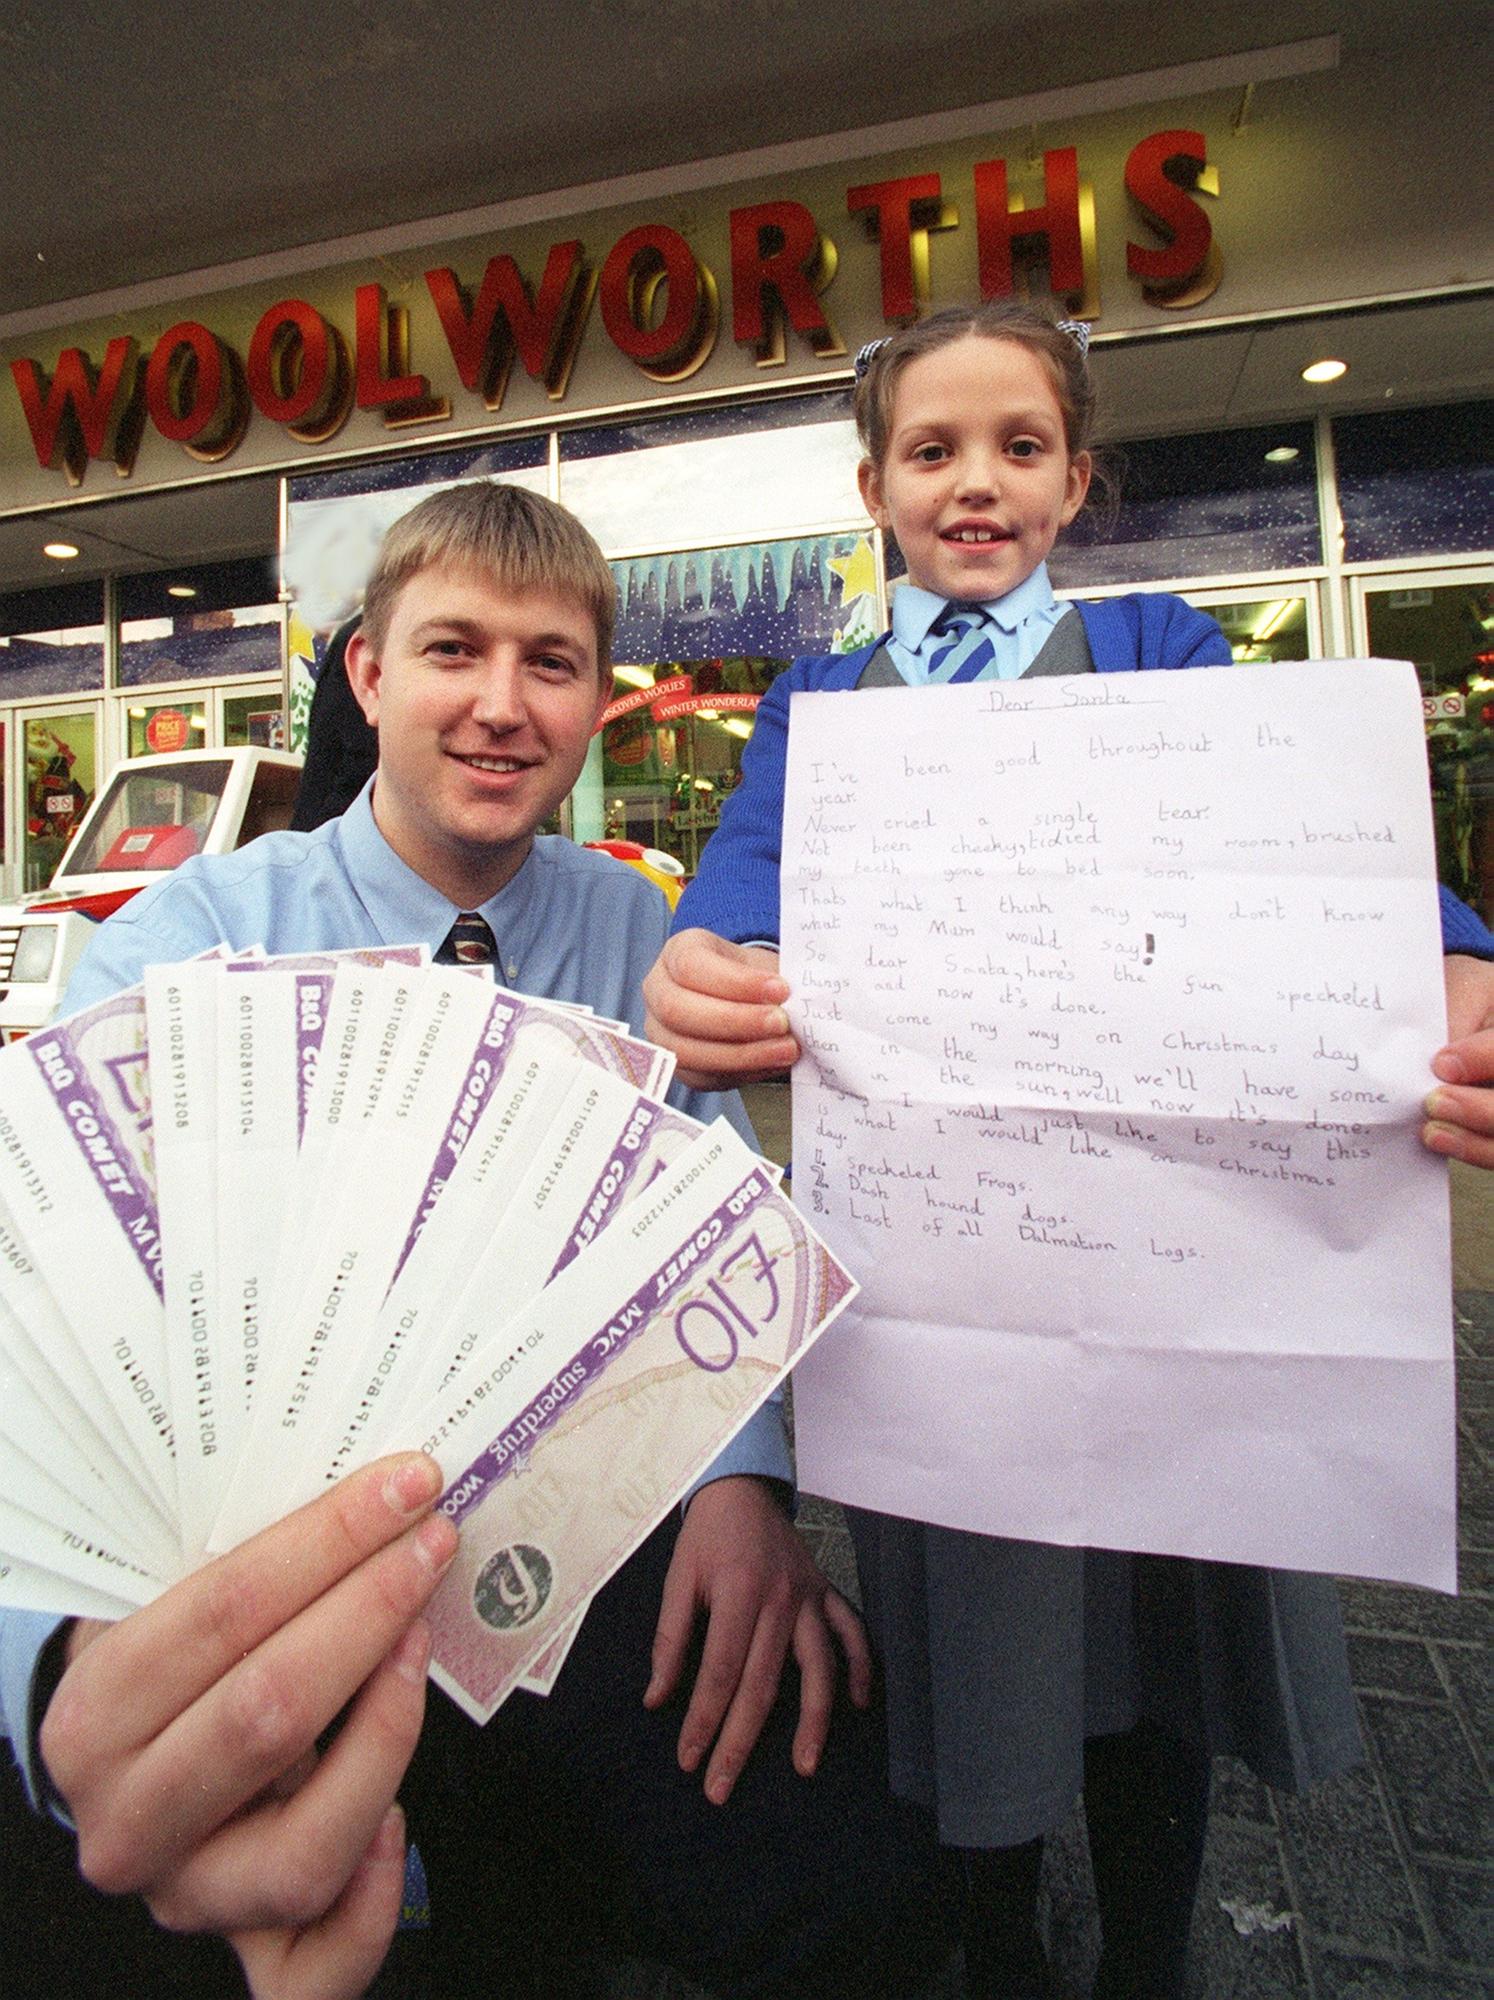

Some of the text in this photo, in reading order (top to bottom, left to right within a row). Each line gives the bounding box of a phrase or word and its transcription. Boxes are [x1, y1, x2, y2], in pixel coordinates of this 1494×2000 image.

[10, 129, 1218, 472] WOOLWORTHS
[644, 679, 687, 700] WOOLIES
[659, 700, 699, 717] WINTER
[989, 682, 1132, 713] Dear Santa
[810, 722, 1297, 784] I've been good throughout the
[800, 838, 832, 857] Not
[871, 834, 912, 855] been
[1151, 832, 1184, 857] my
[803, 814, 857, 835] Never
[883, 808, 937, 831] cried
[977, 815, 991, 827] a
[1033, 801, 1099, 832] single
[853, 858, 902, 876] teeth
[942, 865, 986, 884] gone
[1016, 859, 1038, 877] to
[1064, 857, 1104, 878] bed
[798, 885, 848, 907] Thats
[879, 889, 924, 912] what
[955, 895, 969, 914] I
[999, 893, 1055, 915] think
[1228, 896, 1288, 920] don't
[1322, 899, 1386, 922] know
[799, 914, 842, 932] what
[873, 919, 899, 937] my
[927, 918, 976, 937] Mum
[1005, 925, 1064, 950] would
[800, 972, 851, 994] things
[873, 973, 906, 991] and
[936, 986, 974, 1001] now
[998, 982, 1030, 1010] it's
[803, 940, 827, 963] So
[863, 944, 908, 969] dear
[1113, 963, 1147, 984] the
[1182, 973, 1224, 995] fun
[484, 1002, 516, 1049] B&Q
[800, 998, 1360, 1072] Just come my way on Christmas day
[802, 1024, 841, 1053] then
[943, 1035, 979, 1064] the
[1013, 1058, 1105, 1090] morning
[1134, 1065, 1199, 1092] we'll
[1242, 1069, 1300, 1101] have
[1328, 1087, 1390, 1105] some
[34, 1040, 77, 1091] B&Q
[66, 1098, 140, 1197] COMET
[446, 1058, 492, 1157] COMET
[939, 1063, 976, 1087] the
[1149, 1096, 1195, 1115] now
[1228, 1097, 1268, 1127] it's
[620, 1105, 654, 1151] B&Q
[853, 1108, 897, 1132] what
[933, 1117, 947, 1135] I
[977, 1124, 1044, 1146] would
[1069, 1130, 1113, 1159] like
[1150, 1152, 1178, 1165] on
[900, 1090, 1372, 1162] I would just like to say this
[571, 1159, 626, 1248] COMET
[726, 1176, 764, 1216] B&Q
[809, 1164, 830, 1189] 2.
[848, 1172, 890, 1200] Dash
[923, 1186, 986, 1217] hound
[811, 1188, 831, 1216] 3.
[848, 1196, 893, 1230] Last
[921, 1217, 944, 1238] of
[956, 1219, 984, 1238] all
[654, 1217, 726, 1299] COMET
[591, 1301, 644, 1357] MVC
[673, 1230, 783, 1375] £10
[487, 1360, 588, 1466] superdrug
